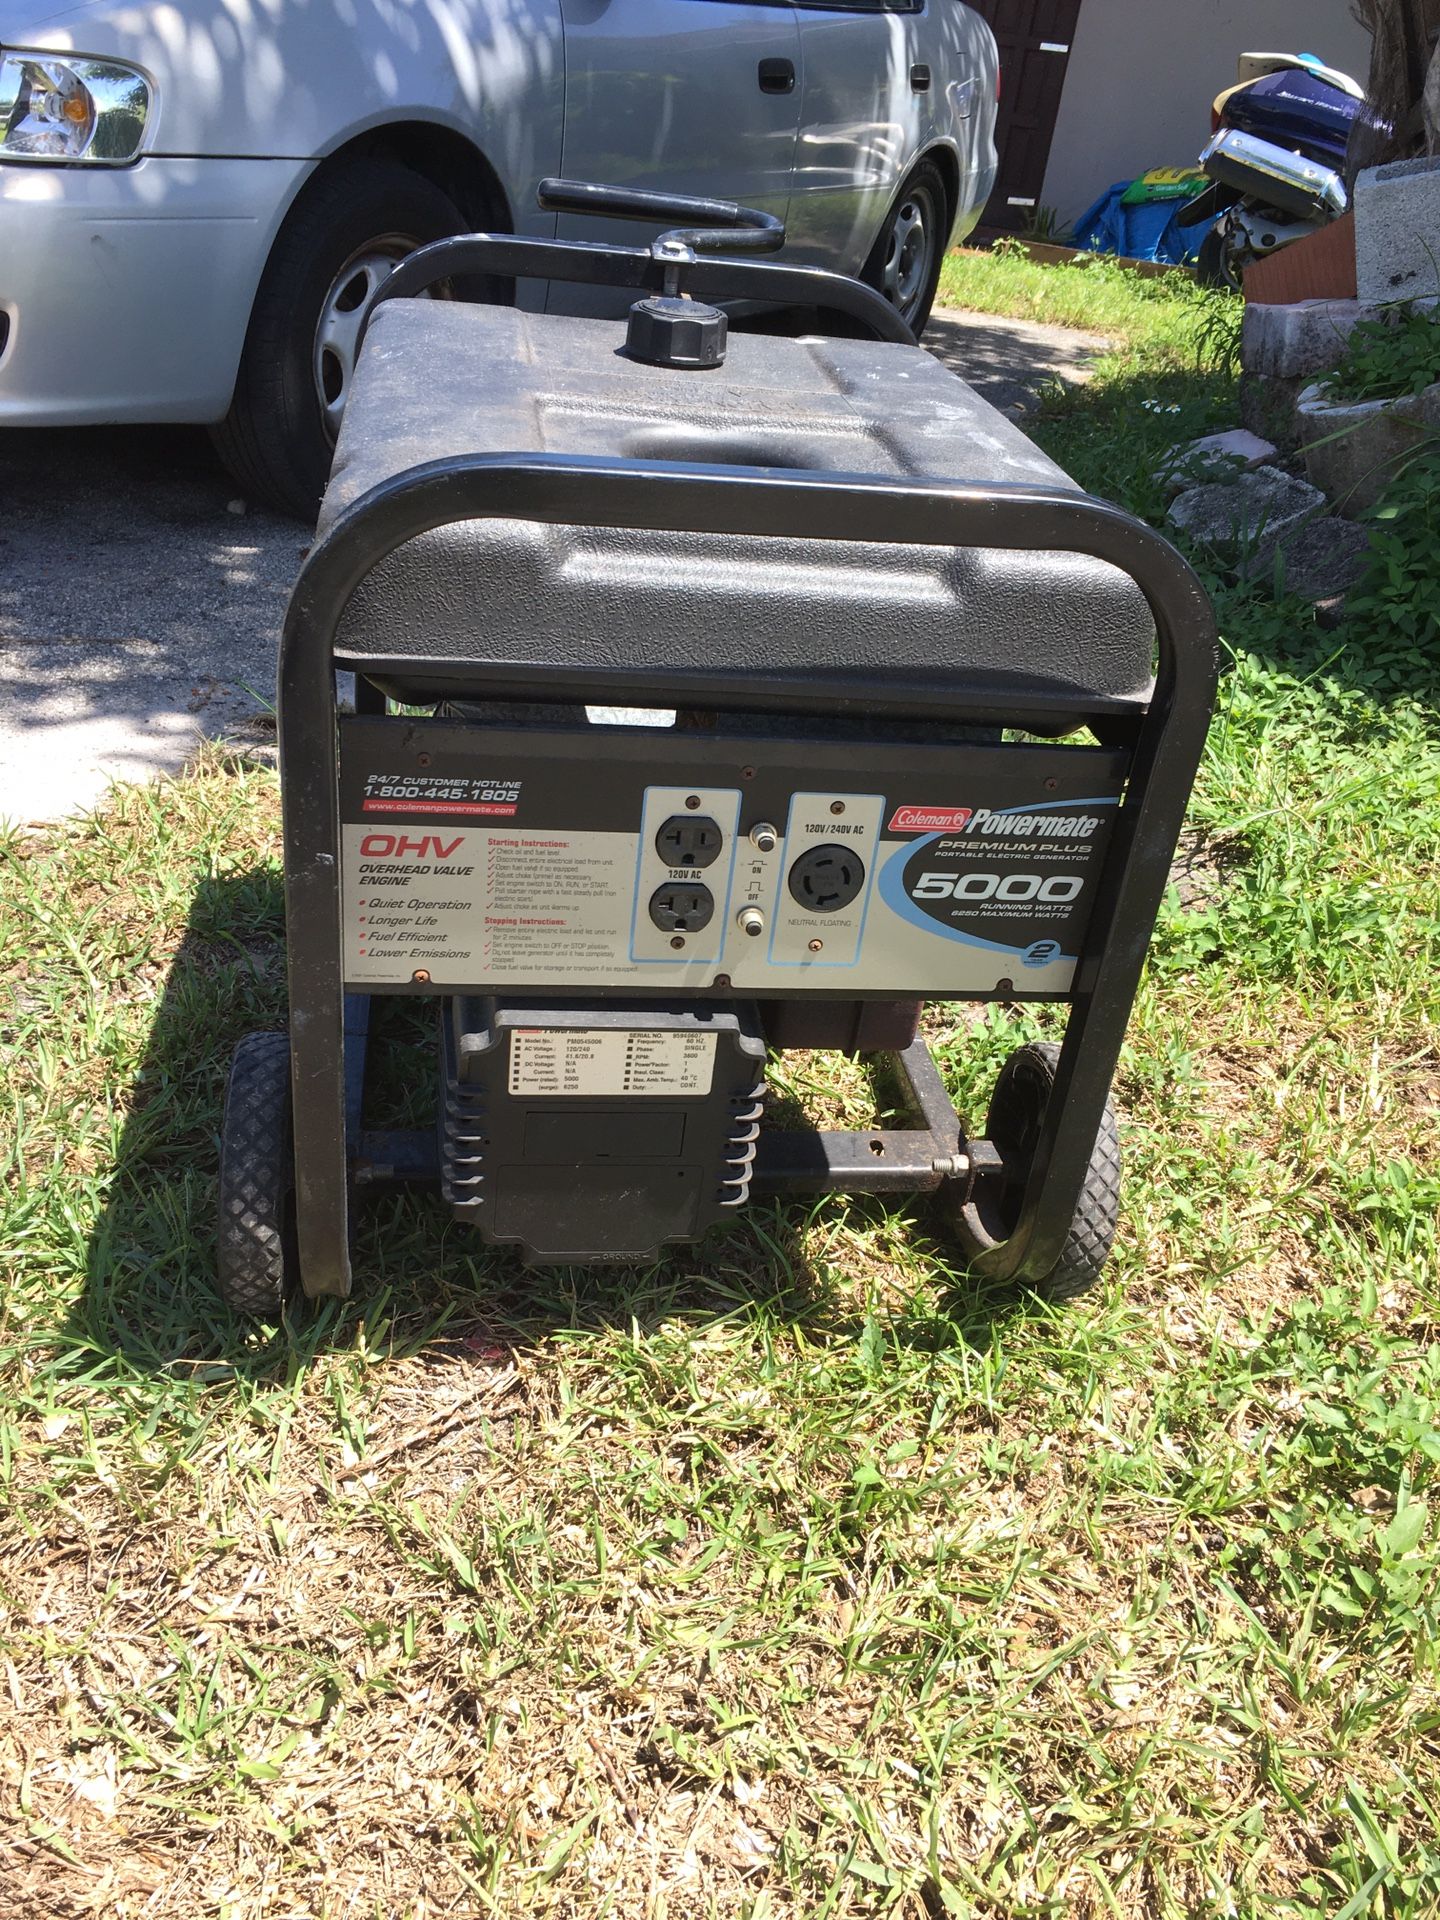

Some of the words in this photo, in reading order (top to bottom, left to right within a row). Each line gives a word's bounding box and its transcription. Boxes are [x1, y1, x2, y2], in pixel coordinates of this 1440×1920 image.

[368, 774, 400, 784] 24/7
[403, 777, 469, 787] CUSTOMER
[472, 780, 522, 788] HOTLINE
[364, 786, 520, 802] 1-800-445-1805
[368, 803, 516, 814] www.colemanpowermate.com
[853, 825, 864, 834] AC
[898, 810, 951, 826] Coleman
[966, 809, 1099, 838] Powermate
[360, 834, 466, 858] OHV
[488, 838, 519, 848] Starting
[521, 839, 570, 848] Instructions:
[938, 841, 1036, 852] PREMIUM
[1038, 844, 1093, 854] PLUS
[358, 864, 431, 875] OVERHEAD
[434, 866, 475, 876] VALVE
[668, 870, 688, 879] 120V
[690, 870, 702, 880] AC
[358, 876, 412, 886] ENGINE
[912, 872, 1084, 902] 5000
[368, 898, 406, 909] Quiet
[408, 898, 472, 910] Operation
[368, 915, 413, 928] Longer
[415, 916, 438, 926] Life
[484, 916, 518, 926] Stopping
[520, 917, 567, 926] Instructions:
[368, 932, 396, 942] Fuel
[398, 932, 448, 942] Efficient
[368, 948, 408, 958] Lower
[410, 948, 471, 958] Emissions
[1028, 944, 1056, 958] 2
